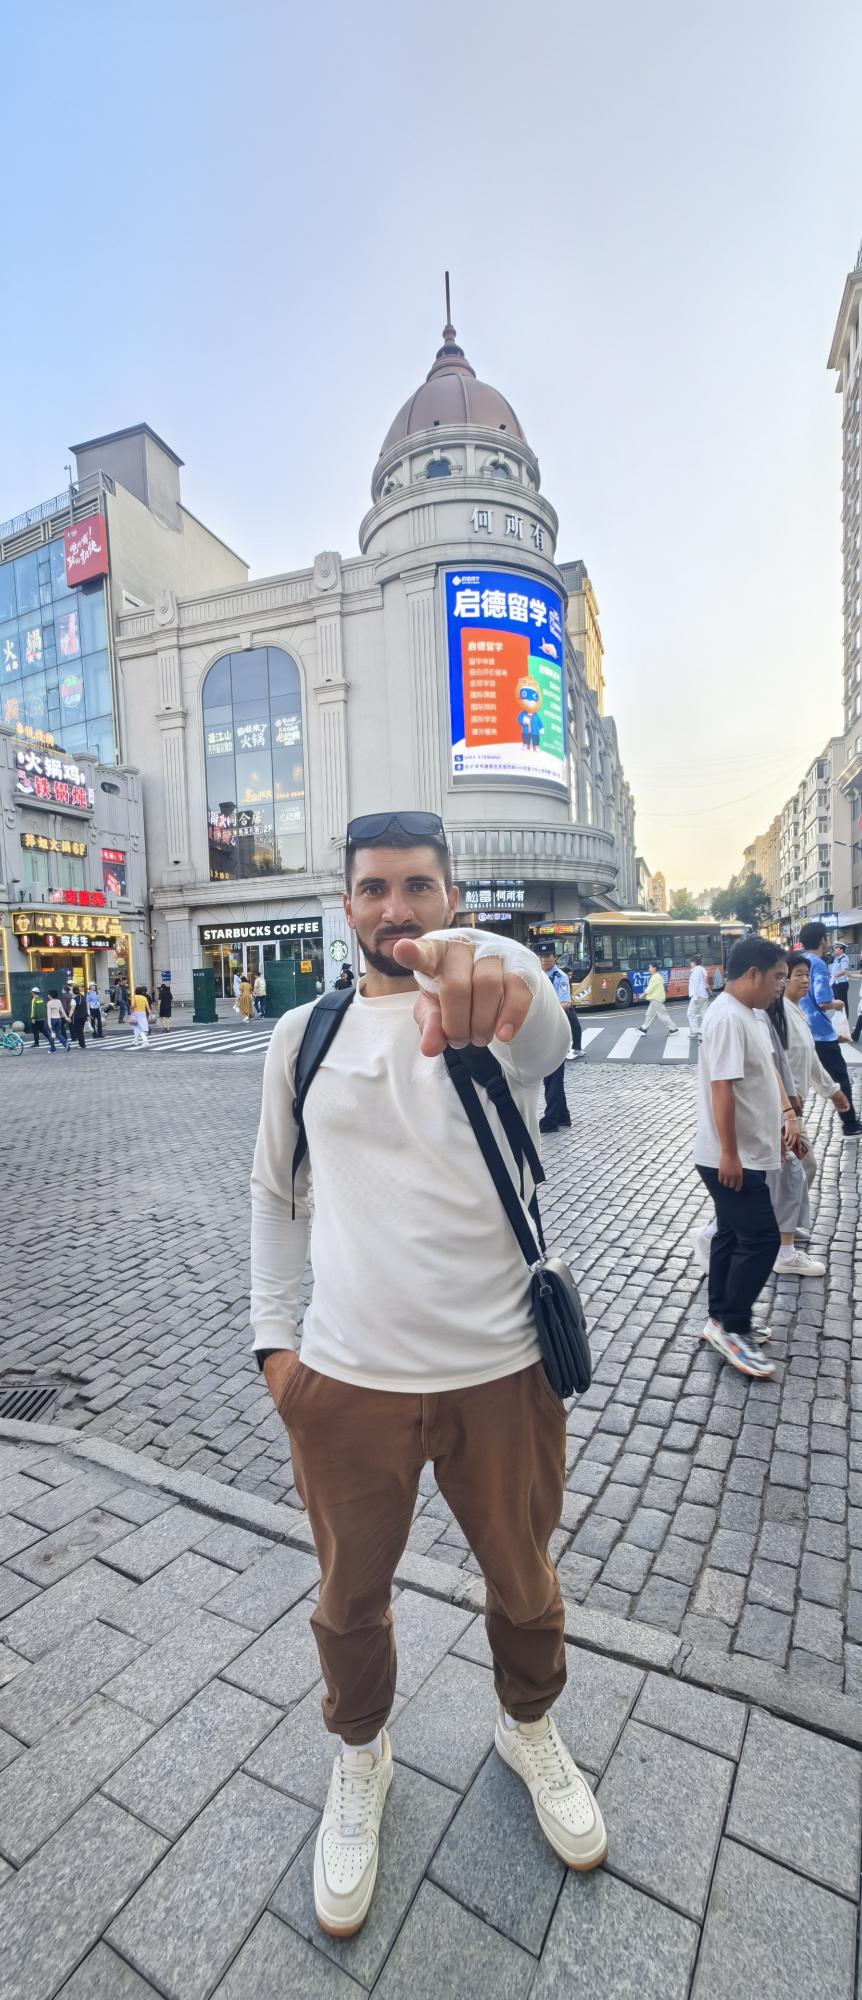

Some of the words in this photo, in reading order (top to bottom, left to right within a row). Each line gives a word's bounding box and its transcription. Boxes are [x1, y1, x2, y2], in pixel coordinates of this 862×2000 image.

[470, 506, 545, 552] 何所有
[453, 588, 548, 628] 启德留学
[241, 732, 265, 748] 火锅
[25, 751, 81, 785] 火锅鸡
[496, 890, 525, 902] 何所有
[204, 926, 271, 940] STARBUCKS
[273, 922, 319, 935] COFFEE
[62, 935, 88, 947] 李先生
